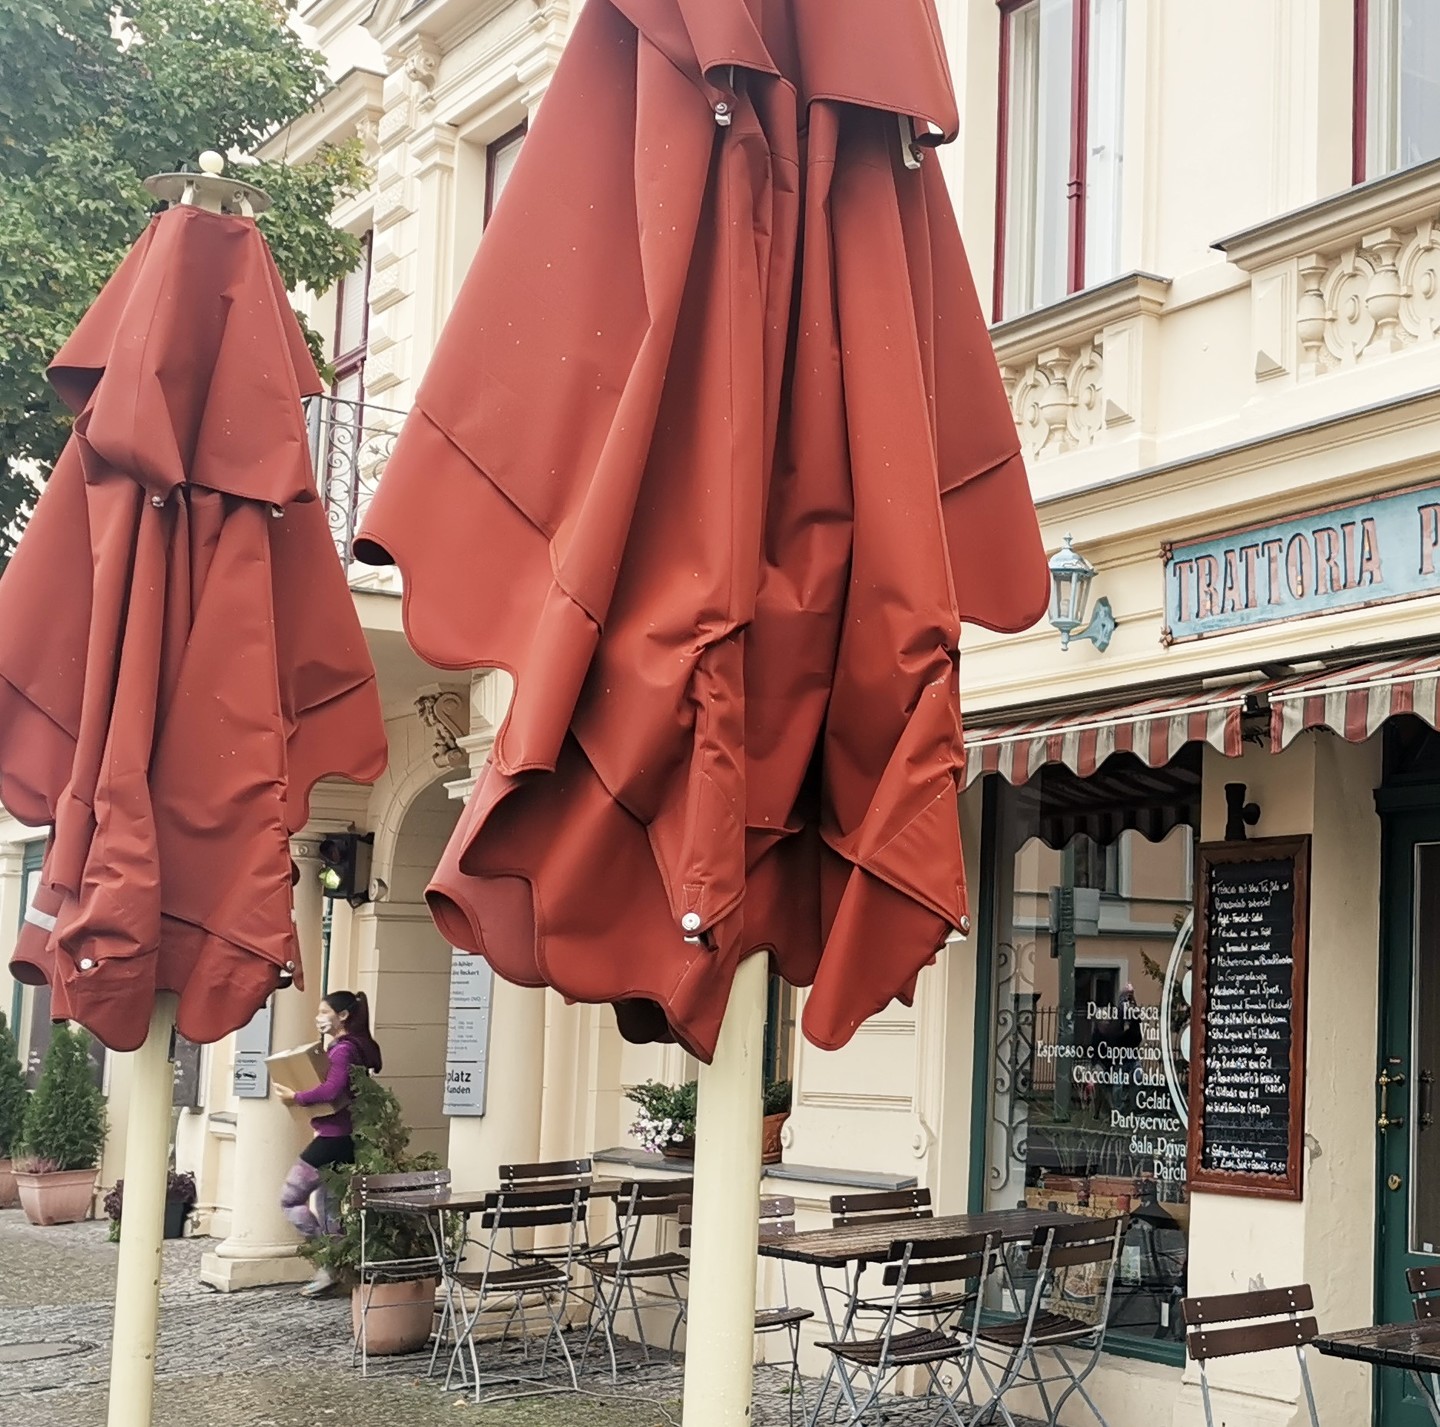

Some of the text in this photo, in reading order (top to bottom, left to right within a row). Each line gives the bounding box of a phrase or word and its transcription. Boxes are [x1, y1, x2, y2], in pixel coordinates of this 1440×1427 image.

[1173, 516, 1382, 623] TRATTORIA
[1087, 1001, 1159, 1020] Pasta Fresca
[1139, 1022, 1160, 1041] Vini
[1037, 1040, 1161, 1065] Espresso e Cappuccino
[1073, 1065, 1166, 1087] Cioccolata Calda
[1135, 1090, 1171, 1110] Gelati
[1110, 1109, 1180, 1133] Partyservice
[1129, 1134, 1153, 1154] Sala
